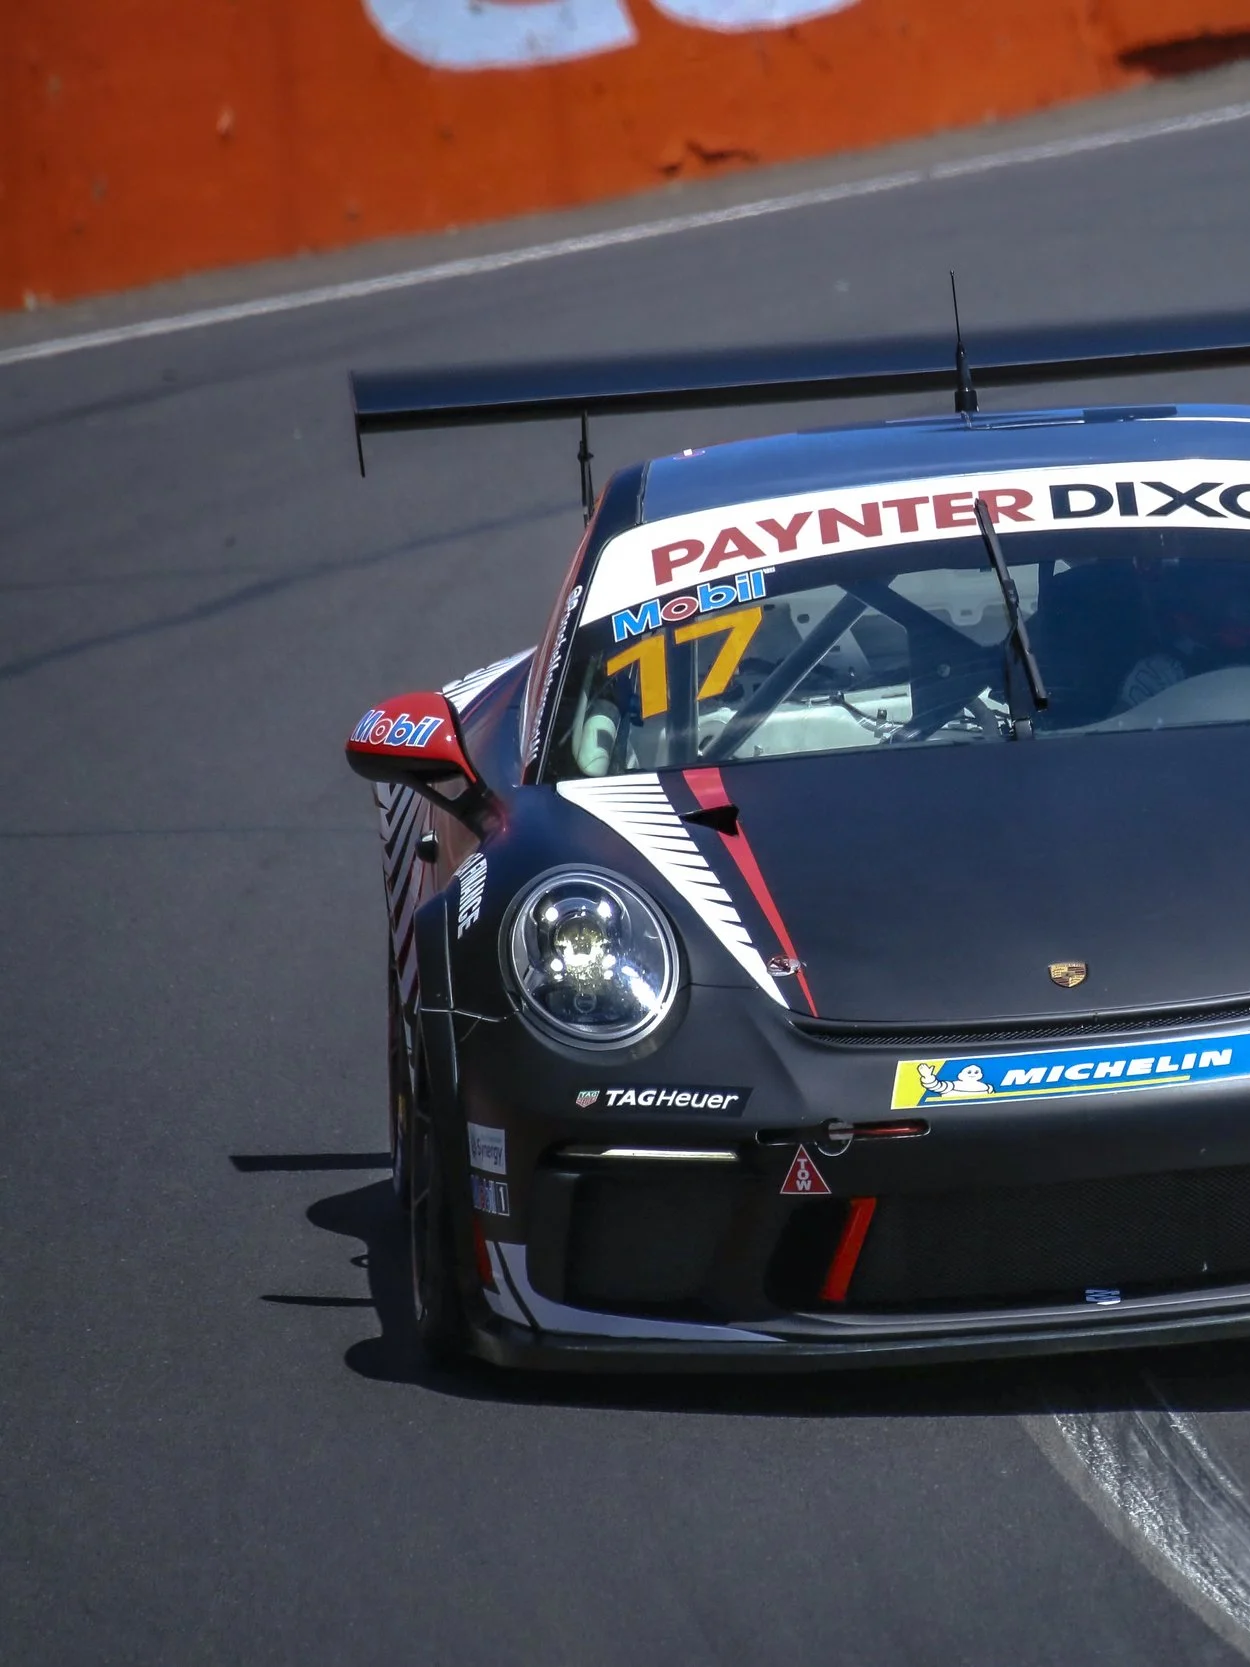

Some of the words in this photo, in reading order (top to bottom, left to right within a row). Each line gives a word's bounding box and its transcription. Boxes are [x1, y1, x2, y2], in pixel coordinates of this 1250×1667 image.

[611, 570, 767, 643] Mobil
[606, 606, 762, 719] 17
[350, 709, 444, 748] Mobil
[1000, 1048, 1233, 1087] MICHELIN
[796, 1158, 811, 1191] TOW
